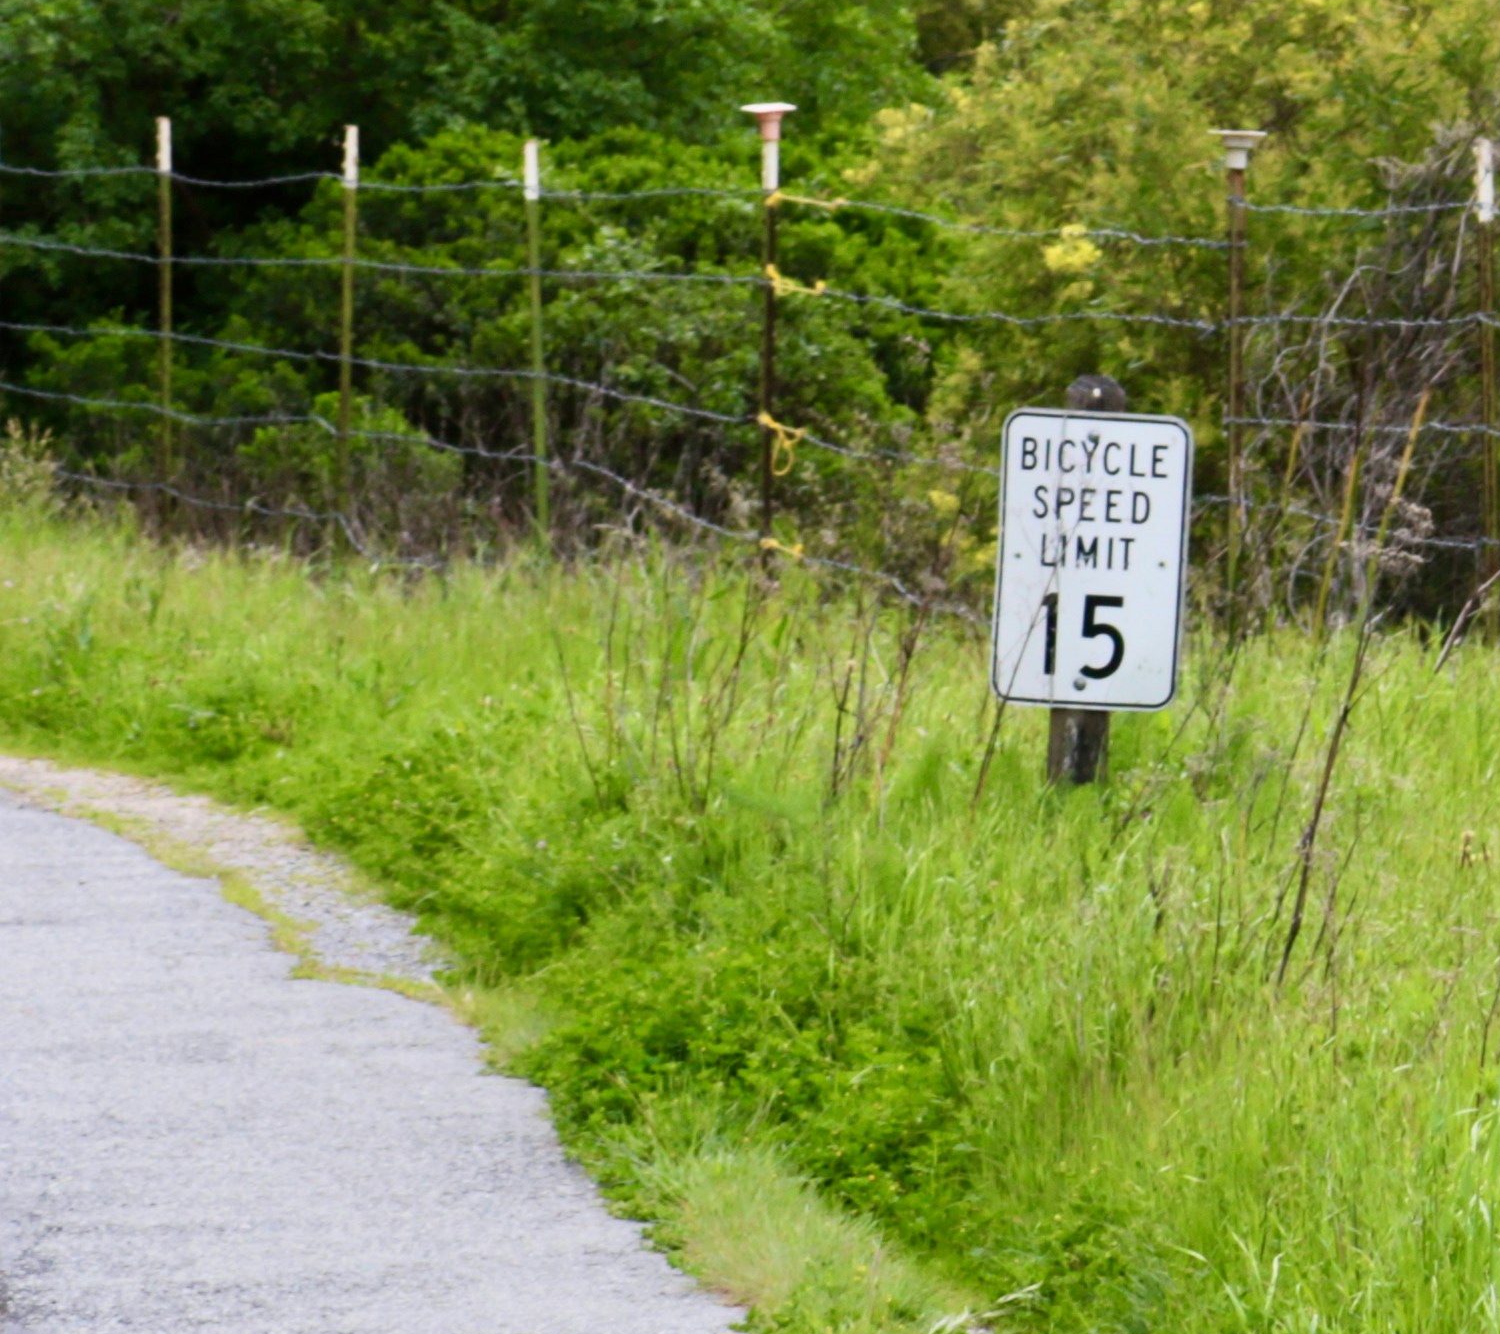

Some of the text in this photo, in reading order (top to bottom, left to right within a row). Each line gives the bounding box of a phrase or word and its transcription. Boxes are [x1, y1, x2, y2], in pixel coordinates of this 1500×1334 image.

[1021, 437, 1169, 479] BICYCLE
[1032, 485, 1151, 525] SPEED
[1040, 533, 1136, 571] LIMIT
[1040, 591, 1126, 680] 15
